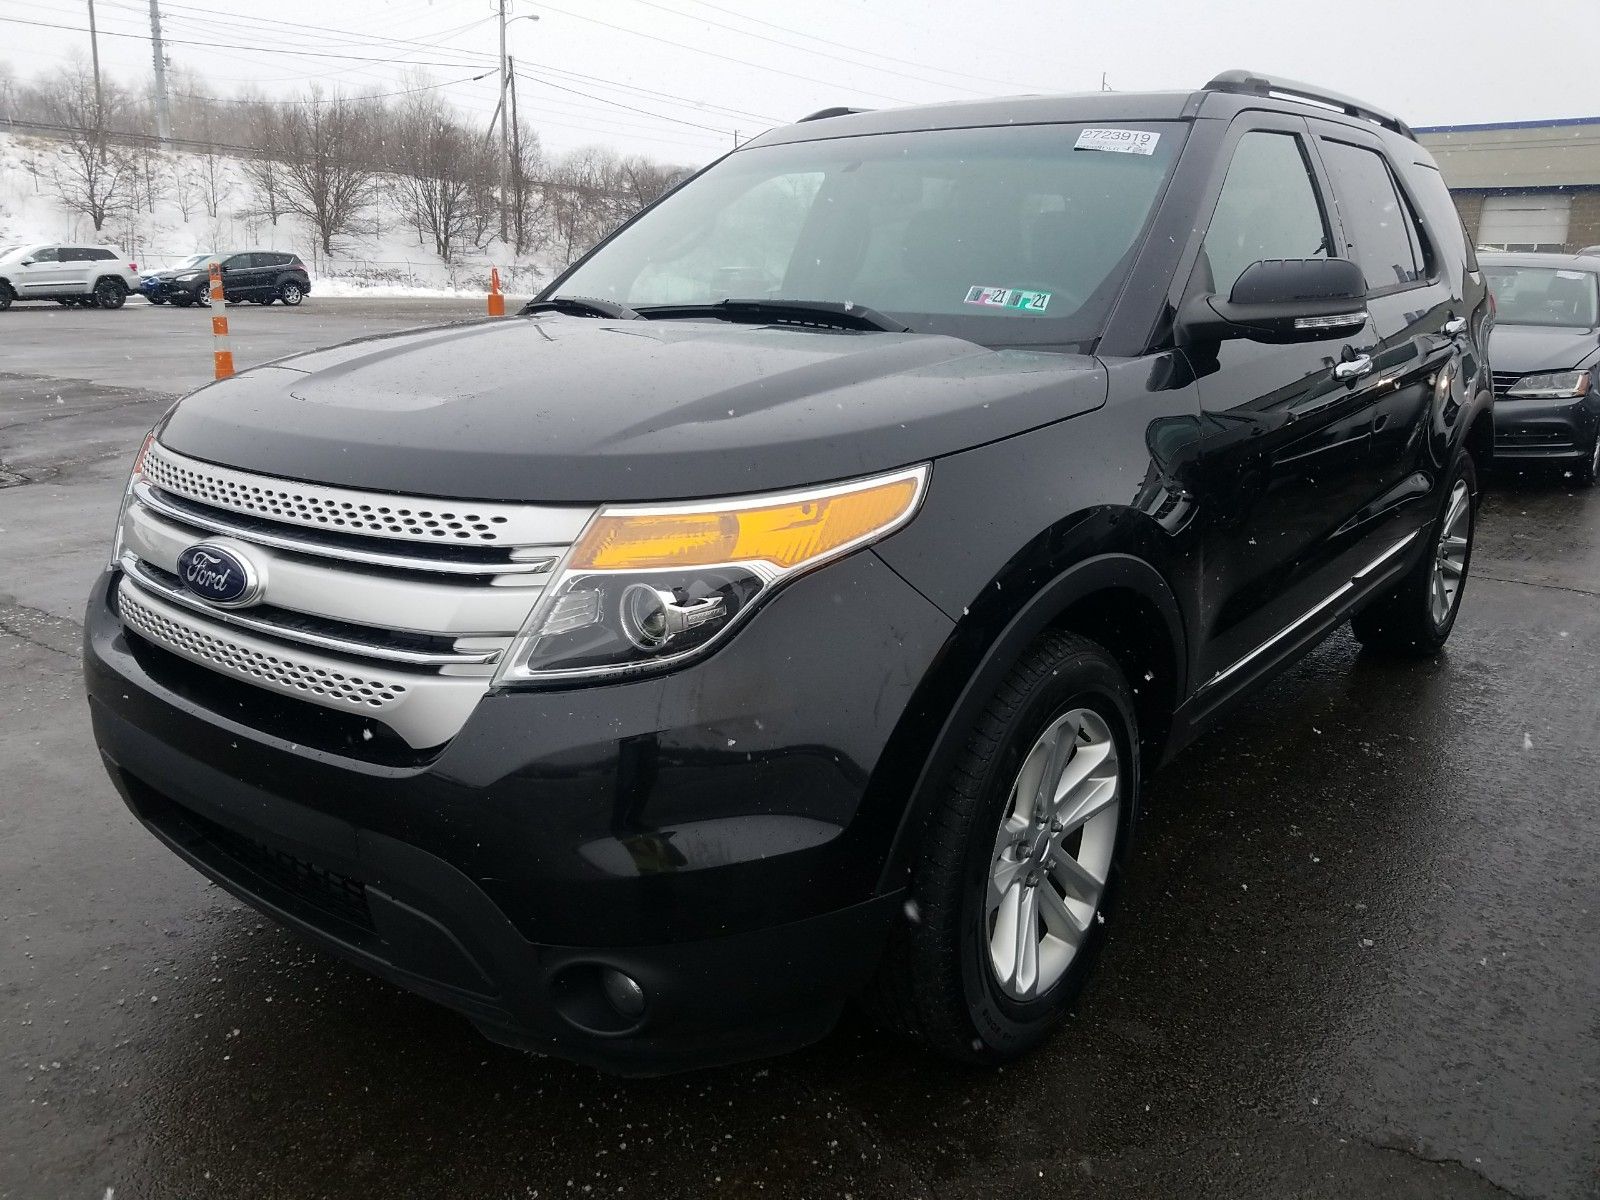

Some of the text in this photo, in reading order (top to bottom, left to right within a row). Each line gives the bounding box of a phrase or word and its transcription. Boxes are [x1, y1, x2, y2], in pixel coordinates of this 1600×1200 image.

[1081, 130, 1151, 143] 2723919
[992, 289, 1007, 304] 21
[1032, 294, 1047, 308] 21
[187, 551, 231, 592] Ford
